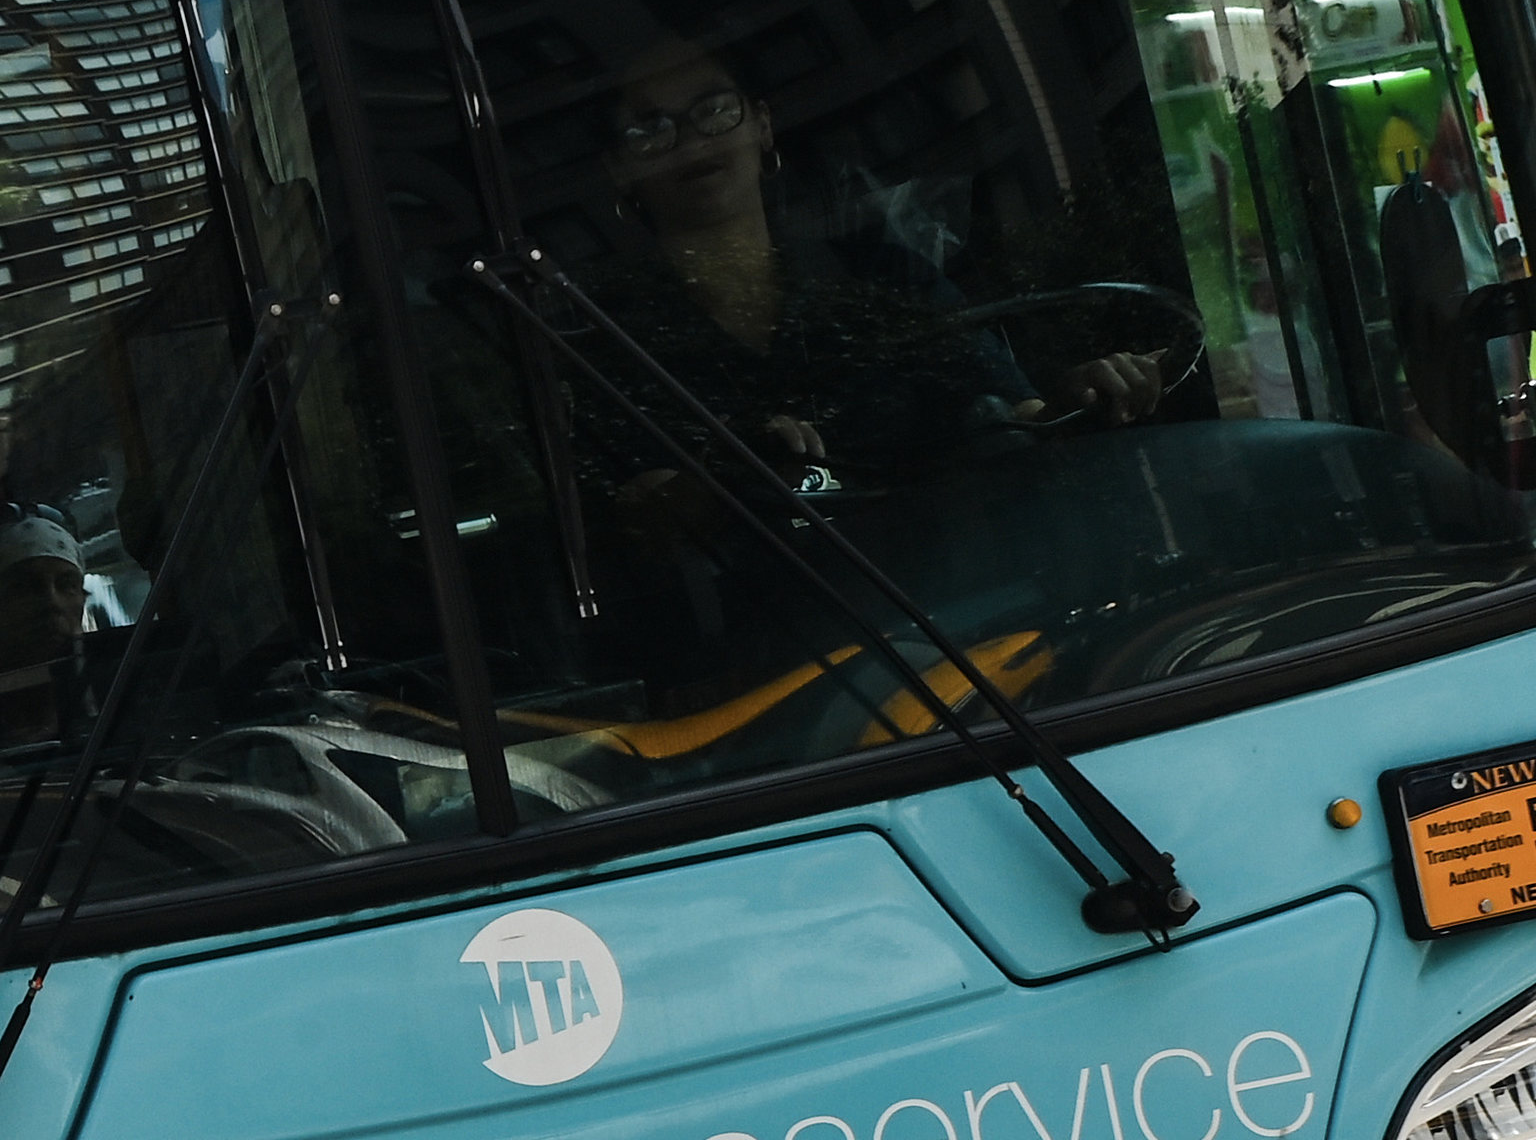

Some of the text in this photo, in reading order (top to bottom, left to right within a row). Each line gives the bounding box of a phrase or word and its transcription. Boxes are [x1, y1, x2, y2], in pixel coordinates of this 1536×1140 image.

[1471, 759, 1536, 794] NEW
[1426, 810, 1512, 838] Metropolitan
[1425, 833, 1523, 865] Transportation
[1449, 862, 1511, 887] Authority
[462, 959, 602, 1058] MTA
